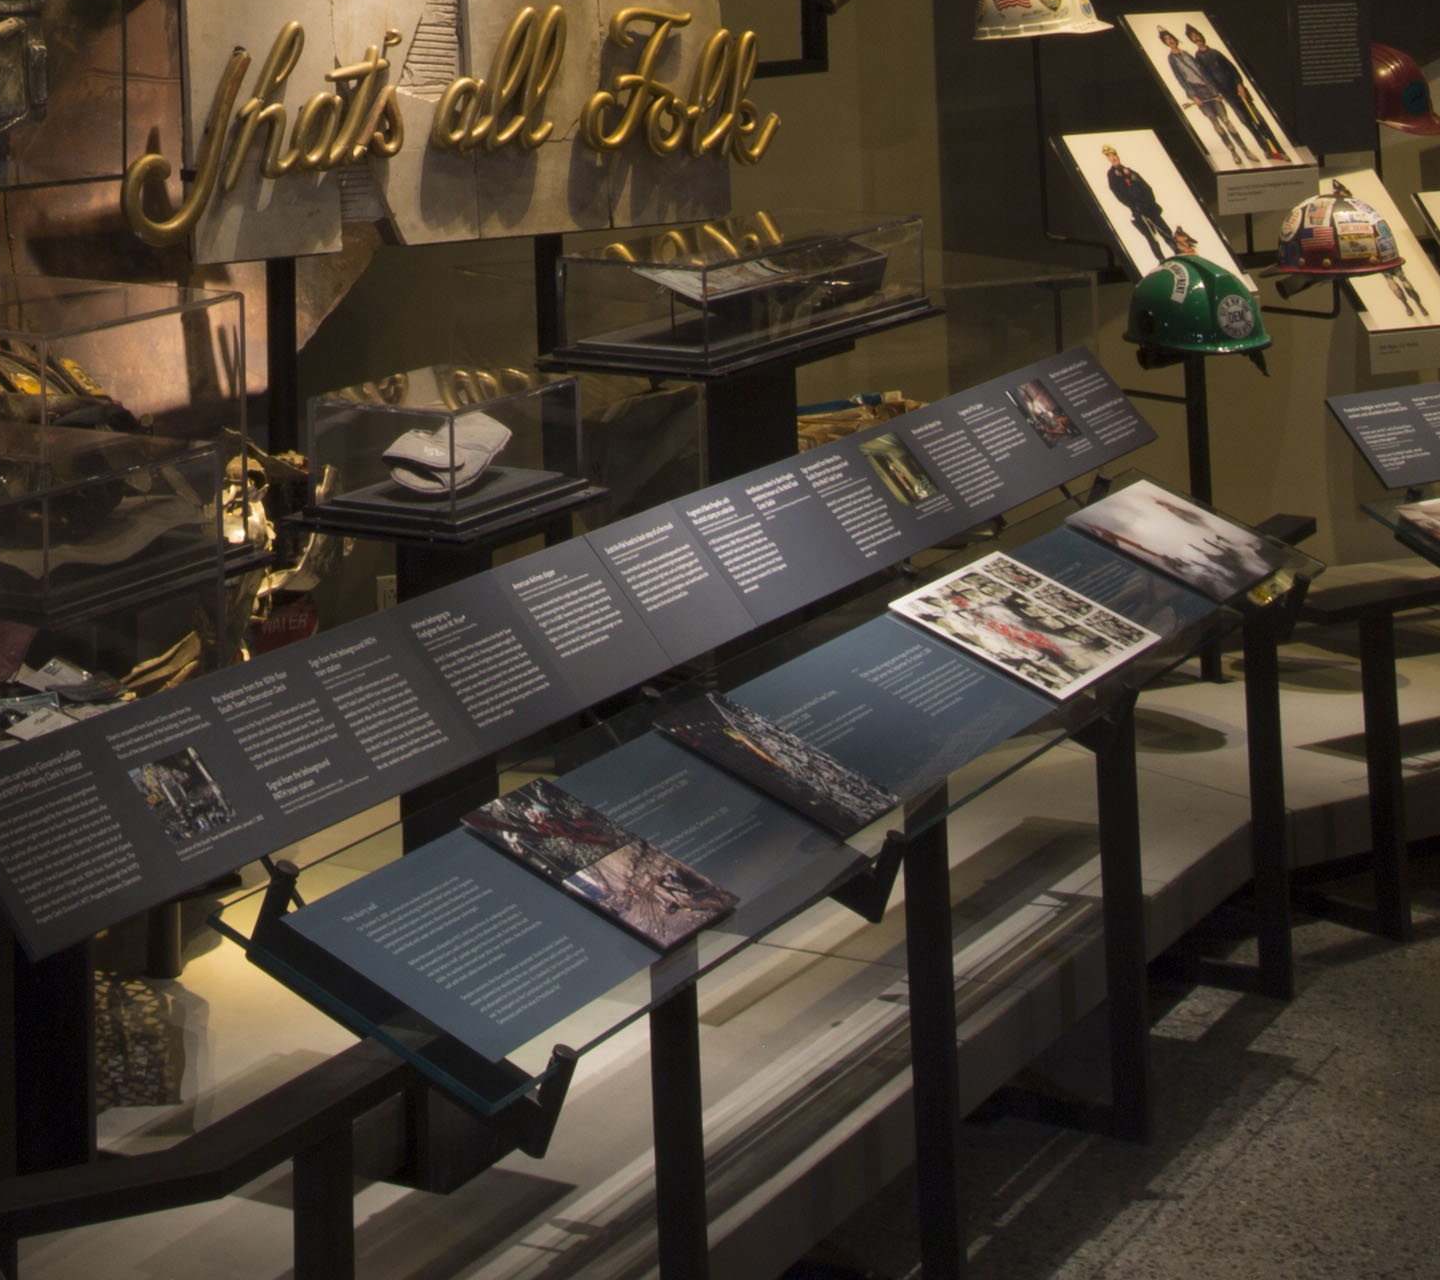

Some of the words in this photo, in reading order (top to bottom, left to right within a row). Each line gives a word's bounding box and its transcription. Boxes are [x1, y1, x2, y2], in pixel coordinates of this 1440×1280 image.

[433, 4, 567, 152] all
[579, 6, 782, 166] Folk
[262, 612, 308, 635] WATER
